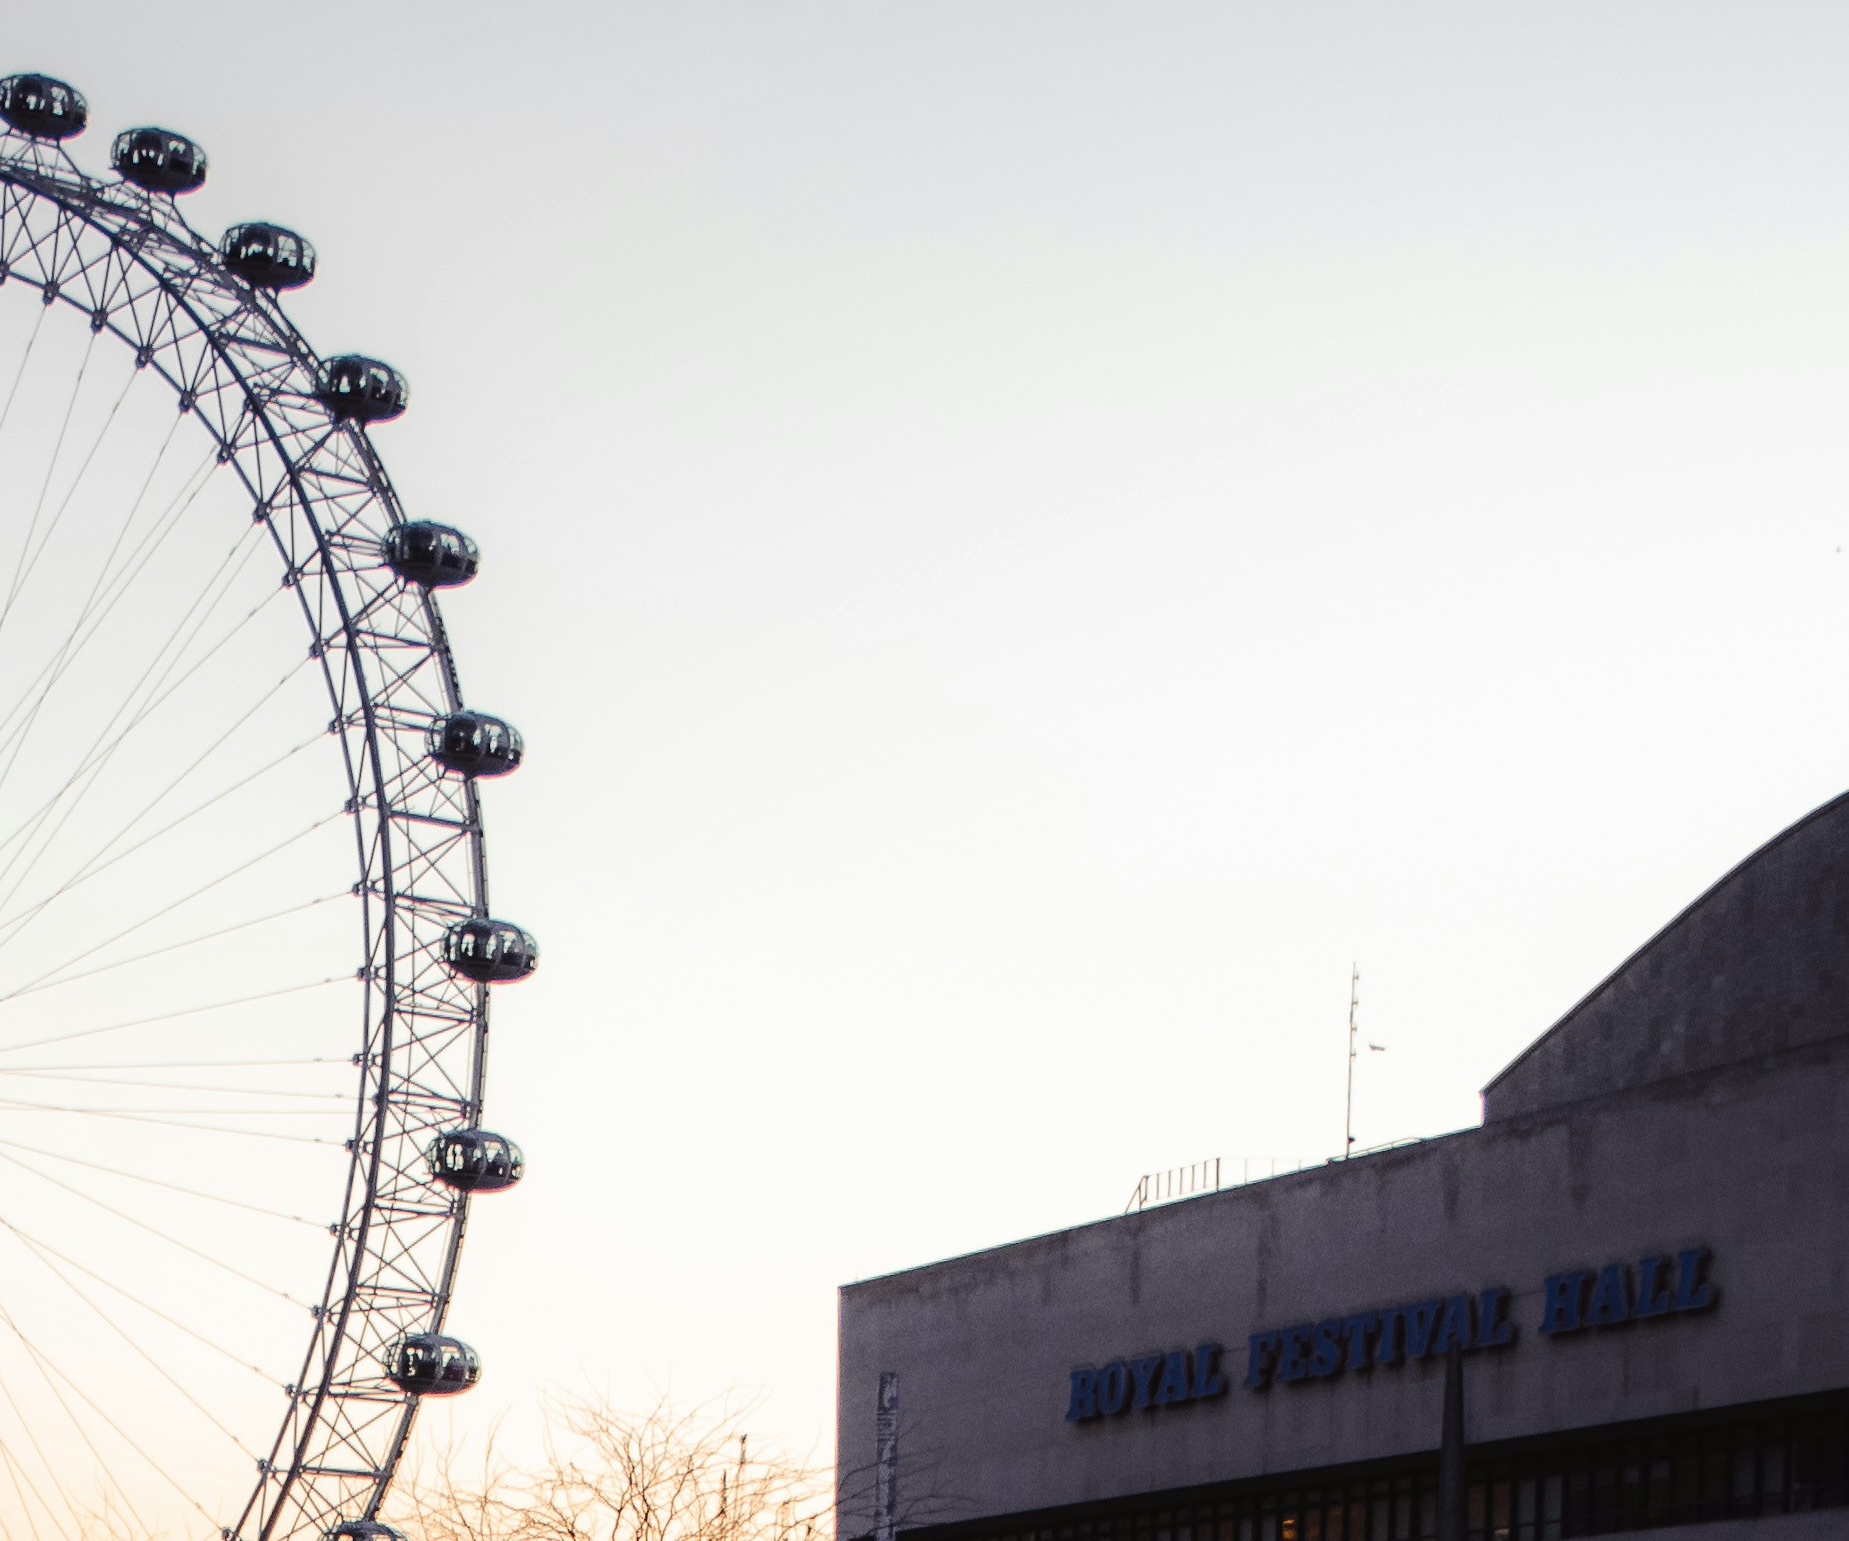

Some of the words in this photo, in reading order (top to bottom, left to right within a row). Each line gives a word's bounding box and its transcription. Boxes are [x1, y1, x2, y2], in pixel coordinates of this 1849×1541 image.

[1065, 1343, 1228, 1423] ROYAL
[1245, 1286, 1518, 1390] FESTIVAL
[1539, 1246, 1715, 1334] HALL
